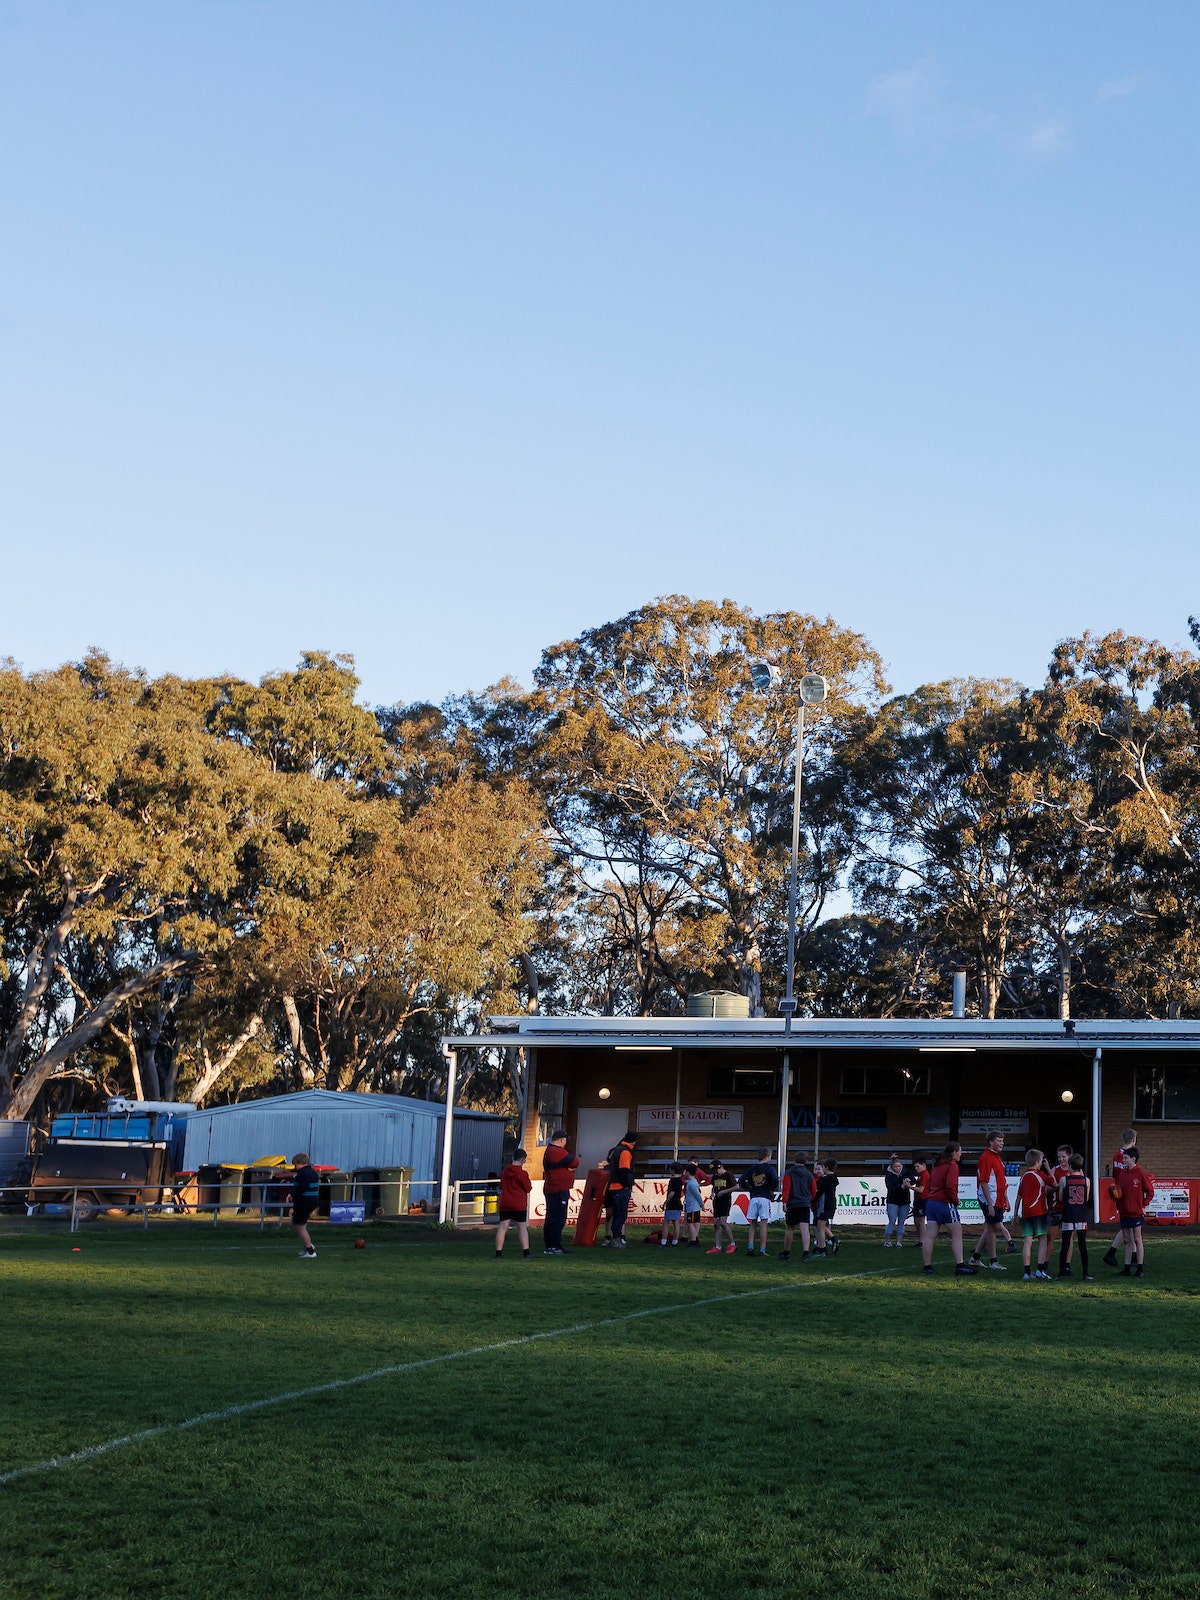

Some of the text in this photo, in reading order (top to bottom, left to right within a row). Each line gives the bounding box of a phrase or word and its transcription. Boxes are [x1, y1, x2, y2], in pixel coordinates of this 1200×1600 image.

[688, 1111, 730, 1120] GALORE
[961, 1108, 1027, 1118] Hamilton Steel
